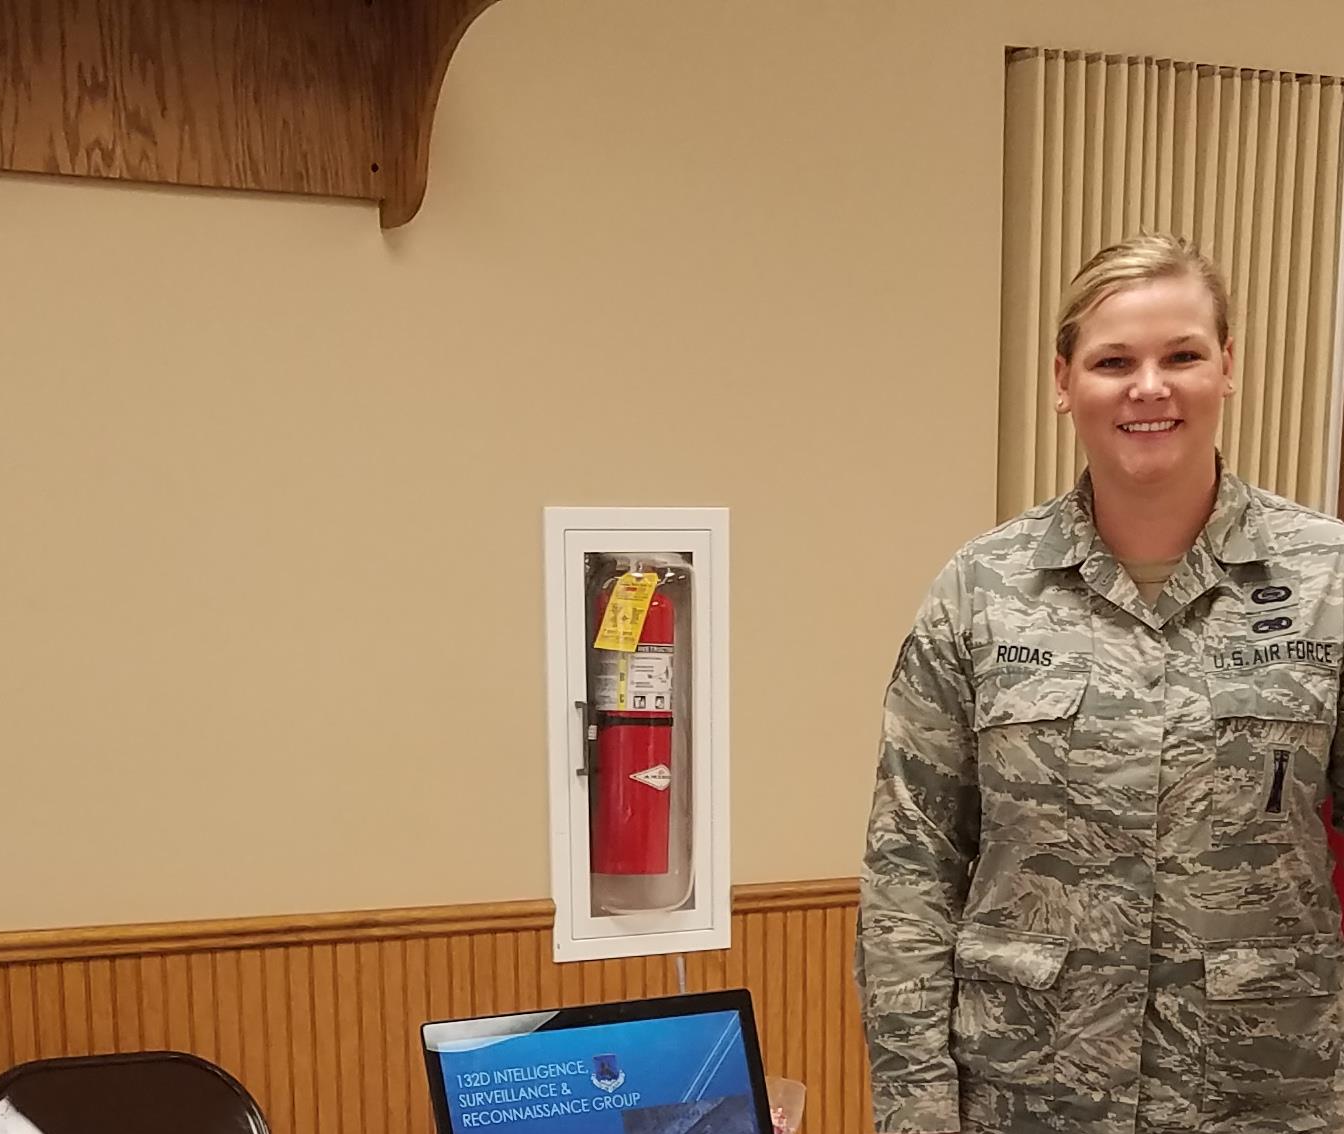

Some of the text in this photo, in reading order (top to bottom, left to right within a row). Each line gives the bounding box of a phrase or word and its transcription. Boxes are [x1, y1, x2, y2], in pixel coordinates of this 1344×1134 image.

[996, 645, 1053, 667] RODAS
[1214, 640, 1333, 668] U.S. AIR FORCE
[457, 1060, 588, 1089] 132D INTELLIGENCE,
[459, 1082, 572, 1109] SURVEILLANCE &
[462, 1092, 641, 1128] RECONNAISSANCE GROUP
